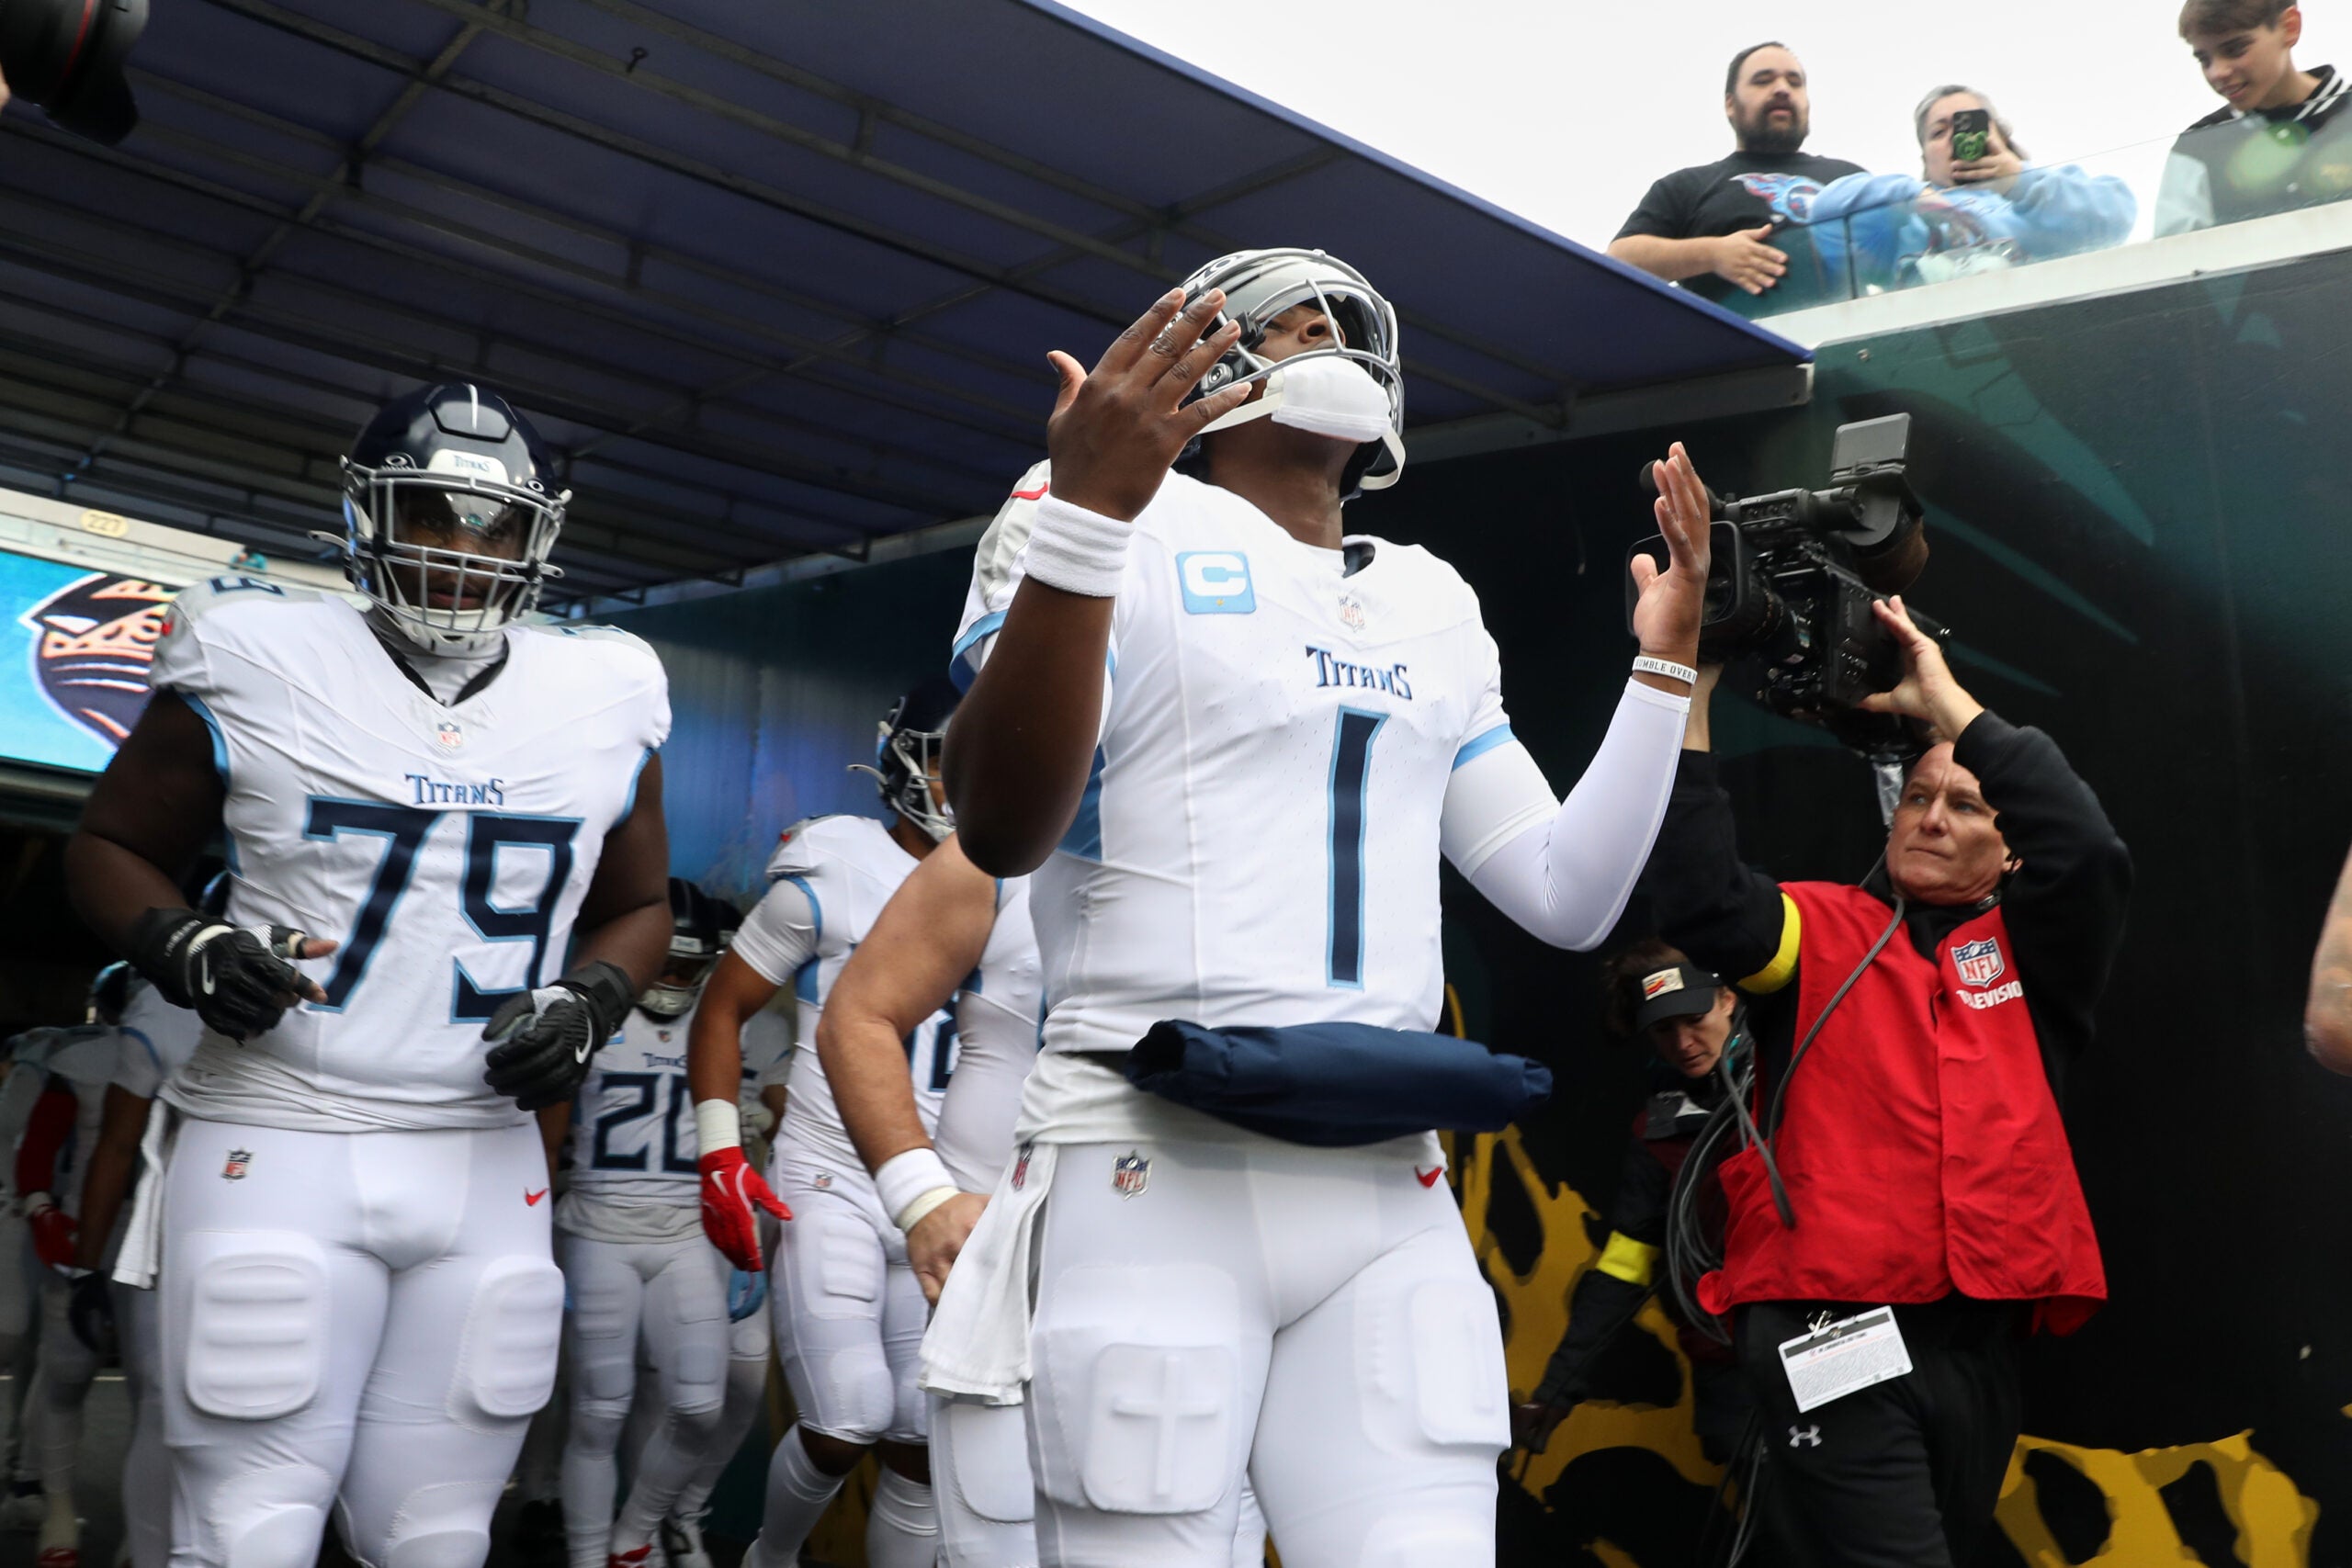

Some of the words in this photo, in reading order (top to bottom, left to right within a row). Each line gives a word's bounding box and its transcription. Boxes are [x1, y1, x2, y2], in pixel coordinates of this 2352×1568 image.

[88, 513, 122, 534] 227
[1183, 554, 1247, 596] C
[1305, 644, 1413, 701] TITANS
[1669, 665, 1692, 681] OVER
[404, 773, 504, 806] TITANS
[1325, 704, 1391, 992] 1
[302, 795, 586, 1025] 79
[1962, 955, 2001, 980] NFL
